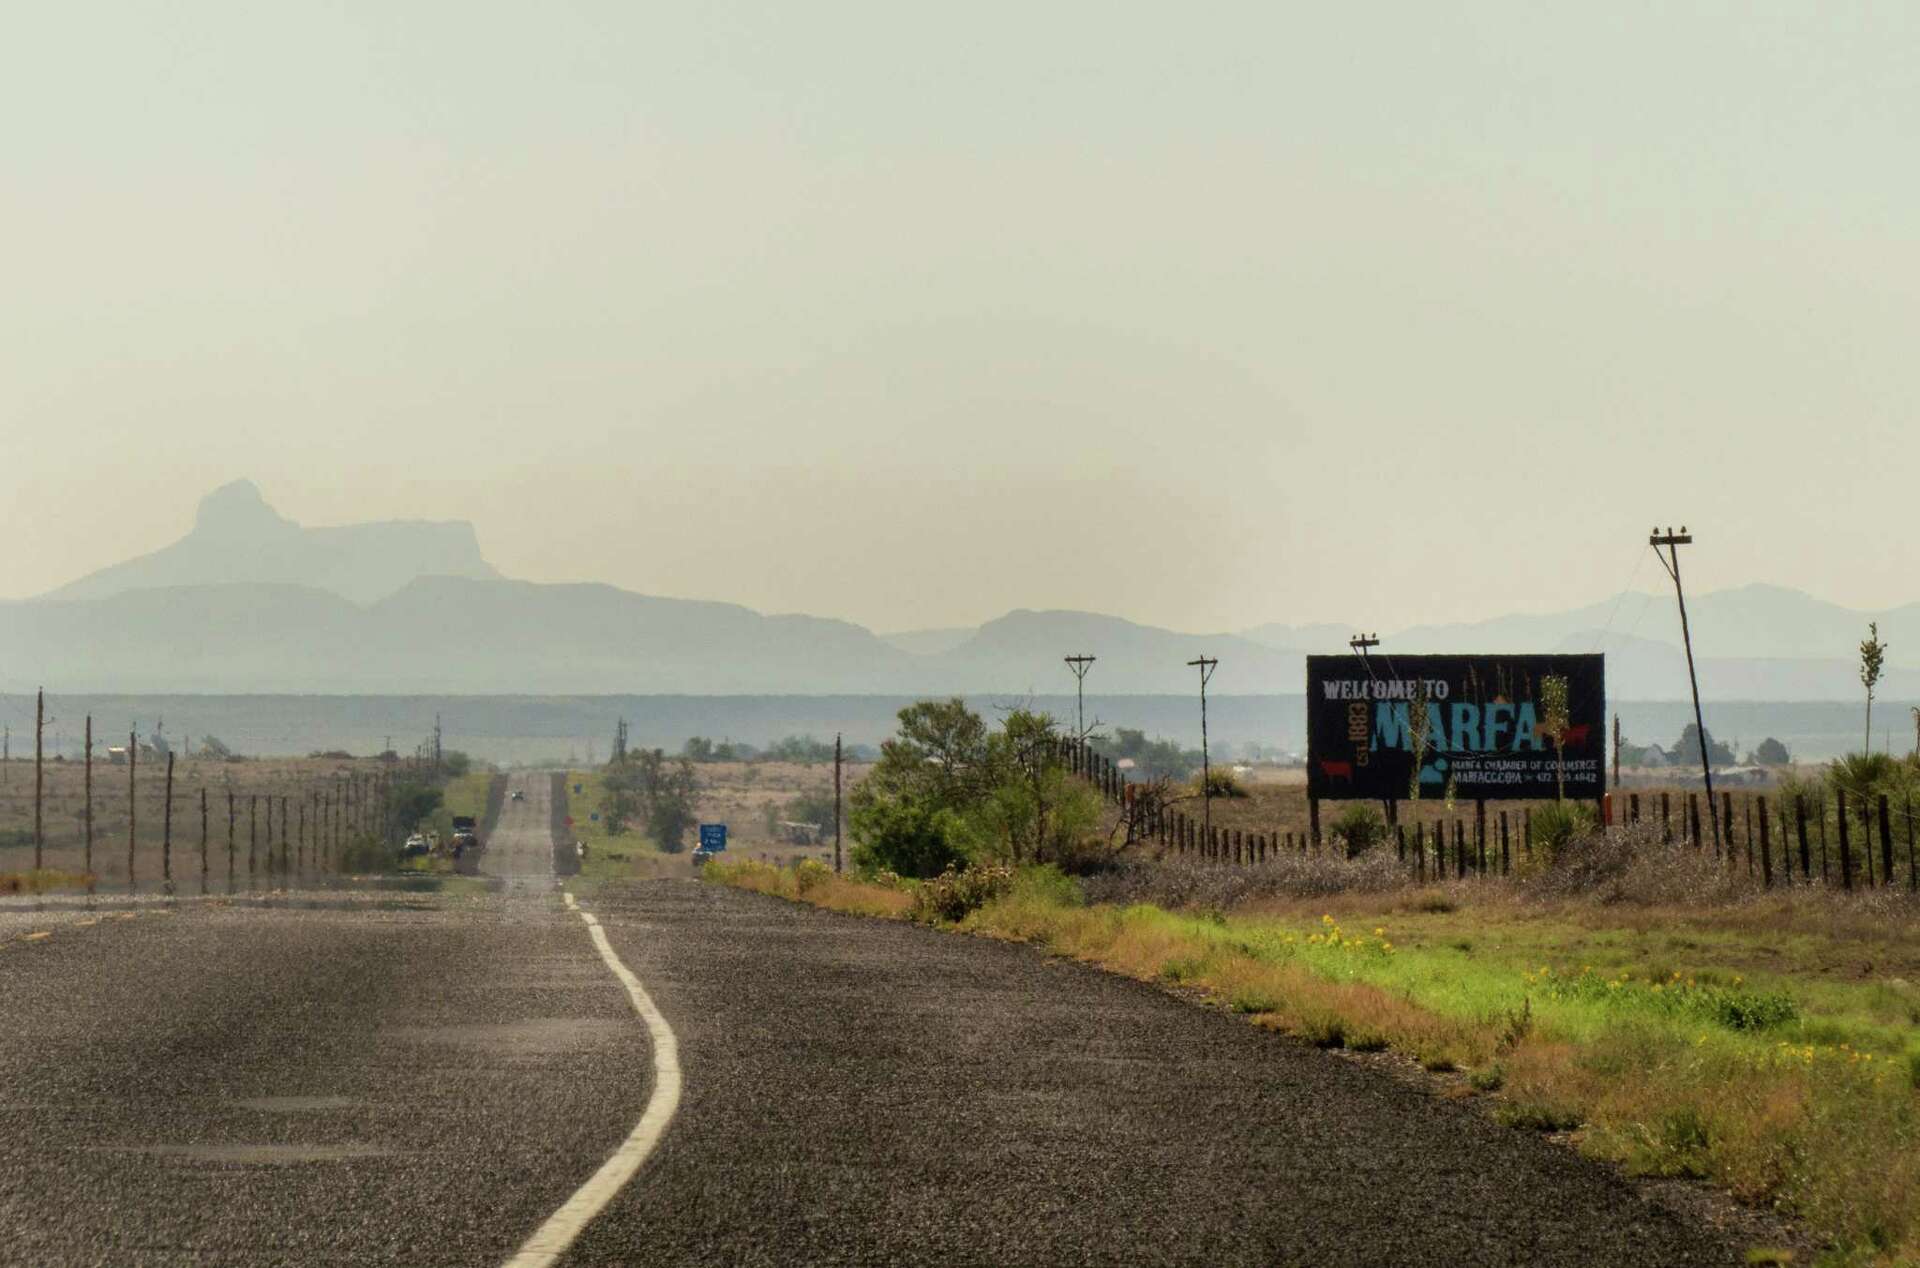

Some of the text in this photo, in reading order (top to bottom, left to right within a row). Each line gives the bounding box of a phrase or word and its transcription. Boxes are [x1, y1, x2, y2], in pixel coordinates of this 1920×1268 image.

[1323, 680, 1449, 700] WELCOME TO
[1369, 702, 1546, 752] MARFA
[1484, 760, 1527, 770] CHAMBER
[1530, 760, 1541, 769] OF
